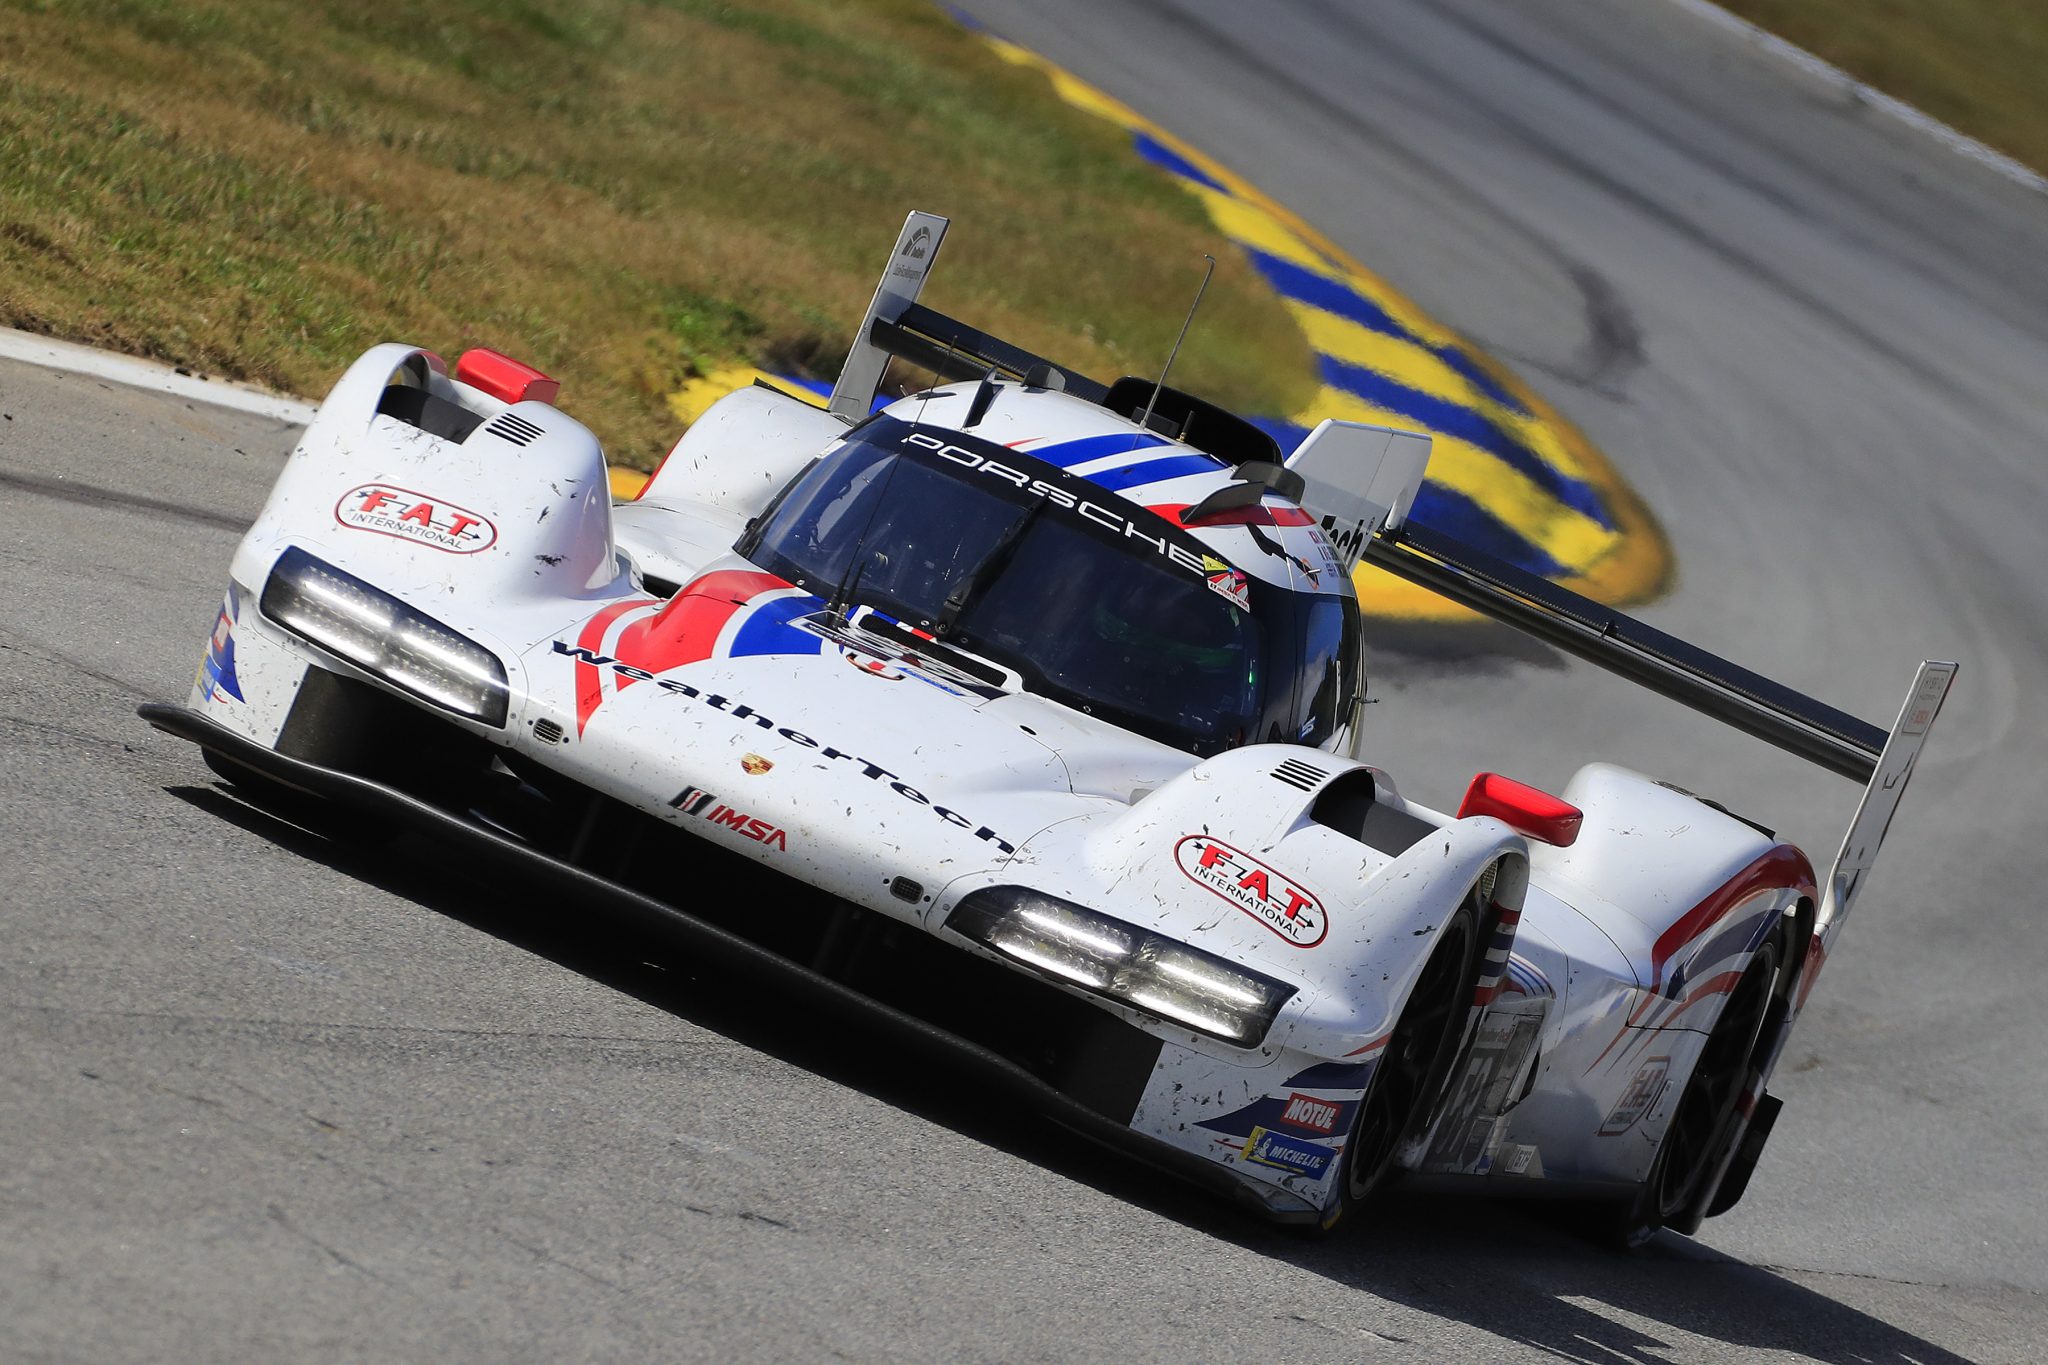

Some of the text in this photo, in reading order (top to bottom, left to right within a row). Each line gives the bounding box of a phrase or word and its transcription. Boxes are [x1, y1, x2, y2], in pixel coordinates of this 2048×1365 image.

[900, 433, 1206, 577] PORSCHE
[351, 512, 463, 550] INTERNATIONAL
[552, 639, 1016, 856] WeatherTech
[705, 804, 787, 852] IMSA
[1193, 865, 1300, 941] INTERNATIONAL
[1283, 1098, 1337, 1130] MOTUL
[1268, 1145, 1326, 1170] MICHELIN
